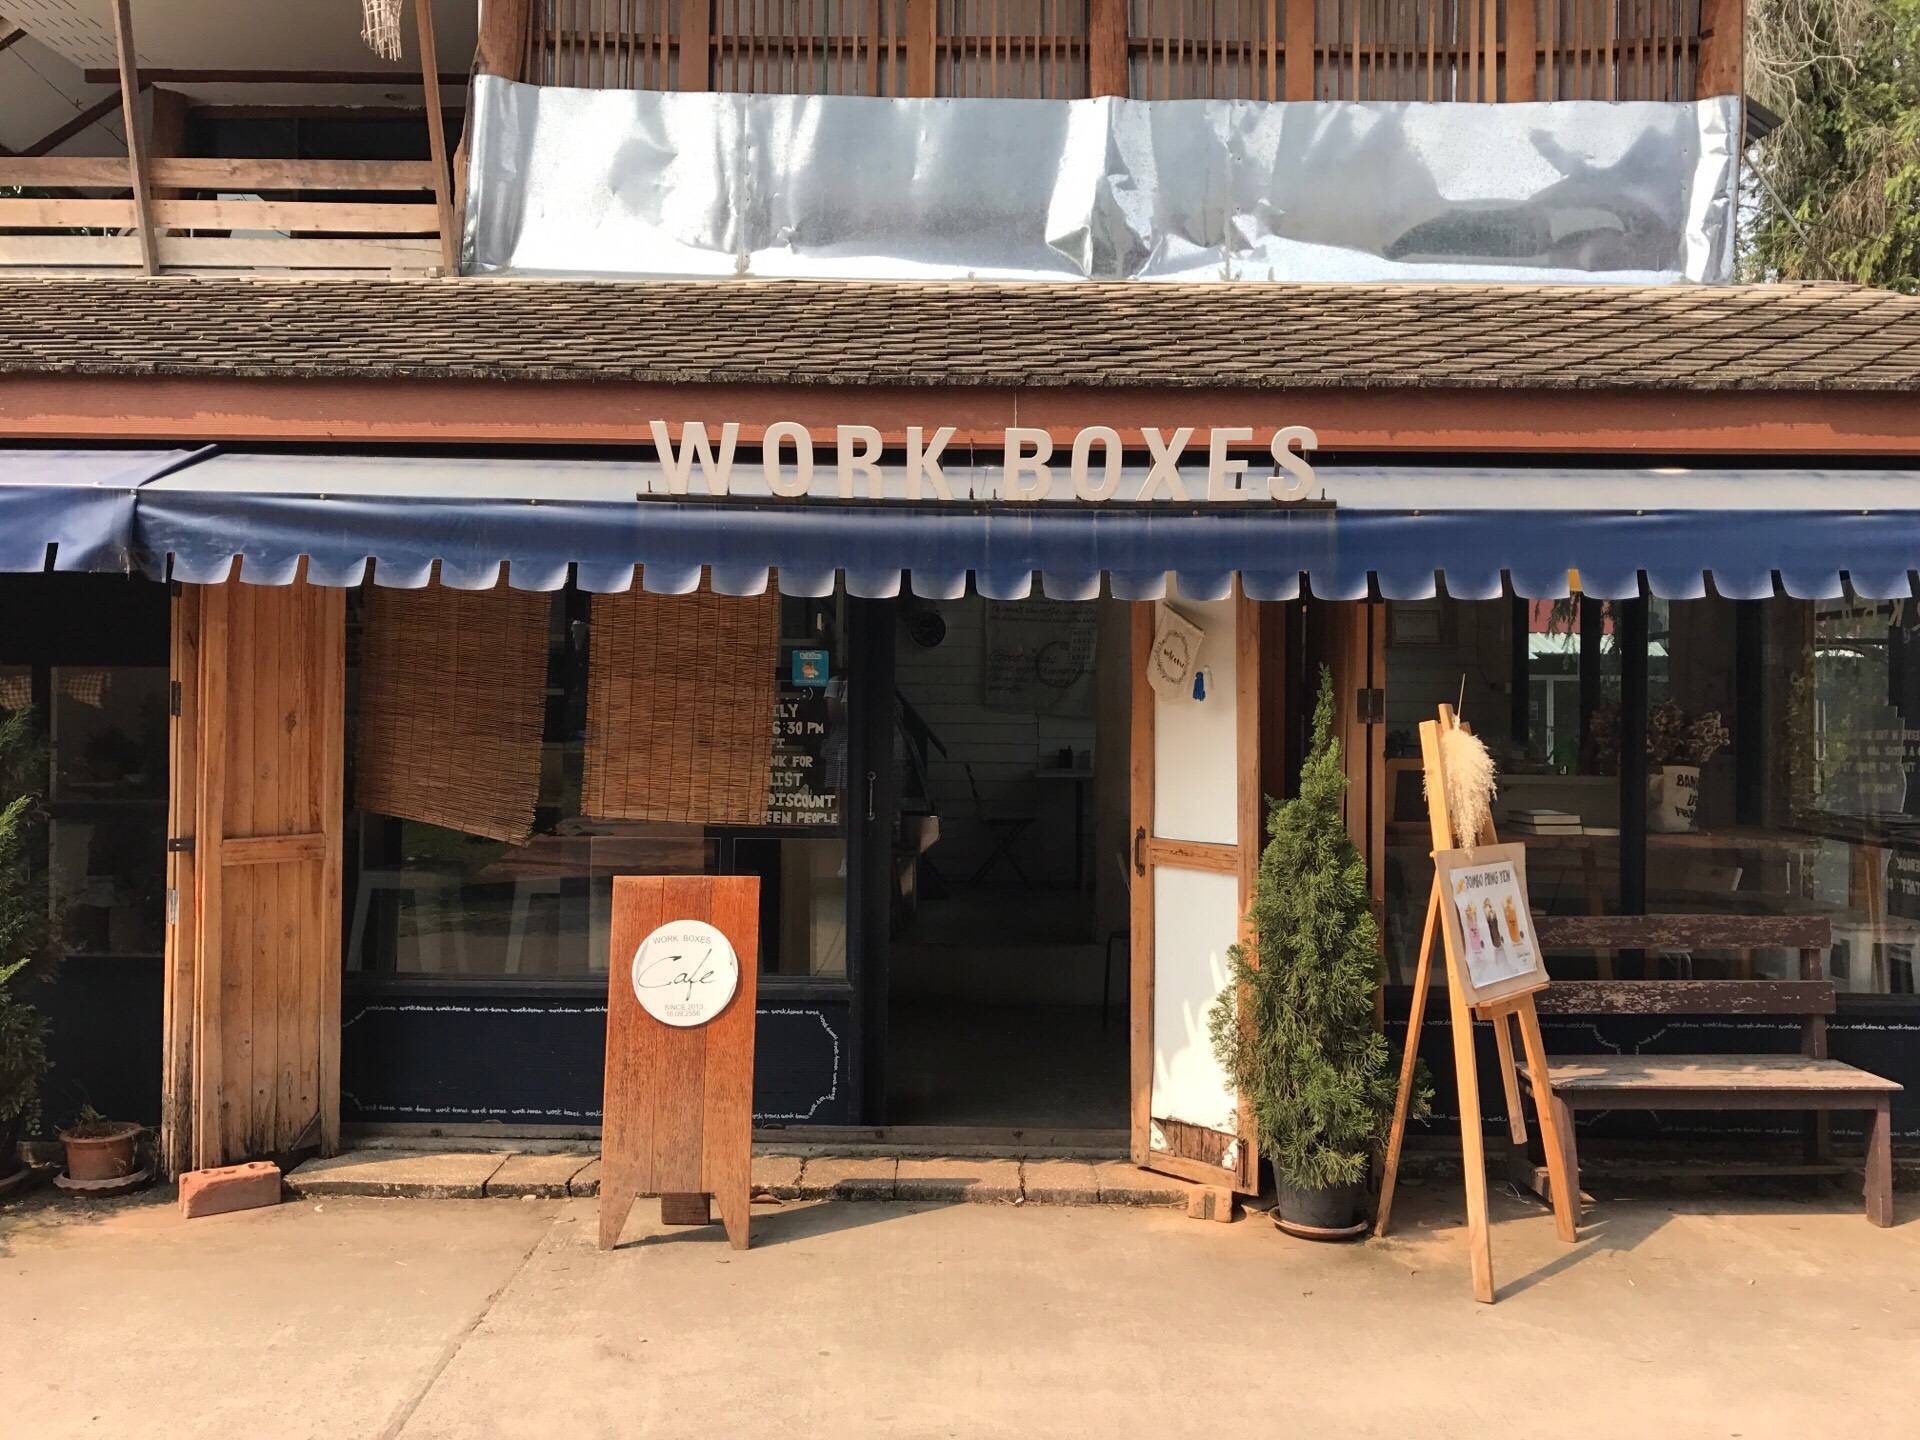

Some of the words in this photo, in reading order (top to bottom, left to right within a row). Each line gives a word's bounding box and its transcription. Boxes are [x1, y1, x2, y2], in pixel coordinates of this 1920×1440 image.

[650, 421, 957, 499] WORK
[1005, 425, 1319, 502] BOXES
[807, 722, 825, 734] PM
[792, 755, 814, 768] FOR
[768, 792, 836, 809] DISCOUNT
[796, 812, 838, 825] PEOPLE
[653, 935, 679, 945] WORK
[683, 935, 712, 945] BOXES
